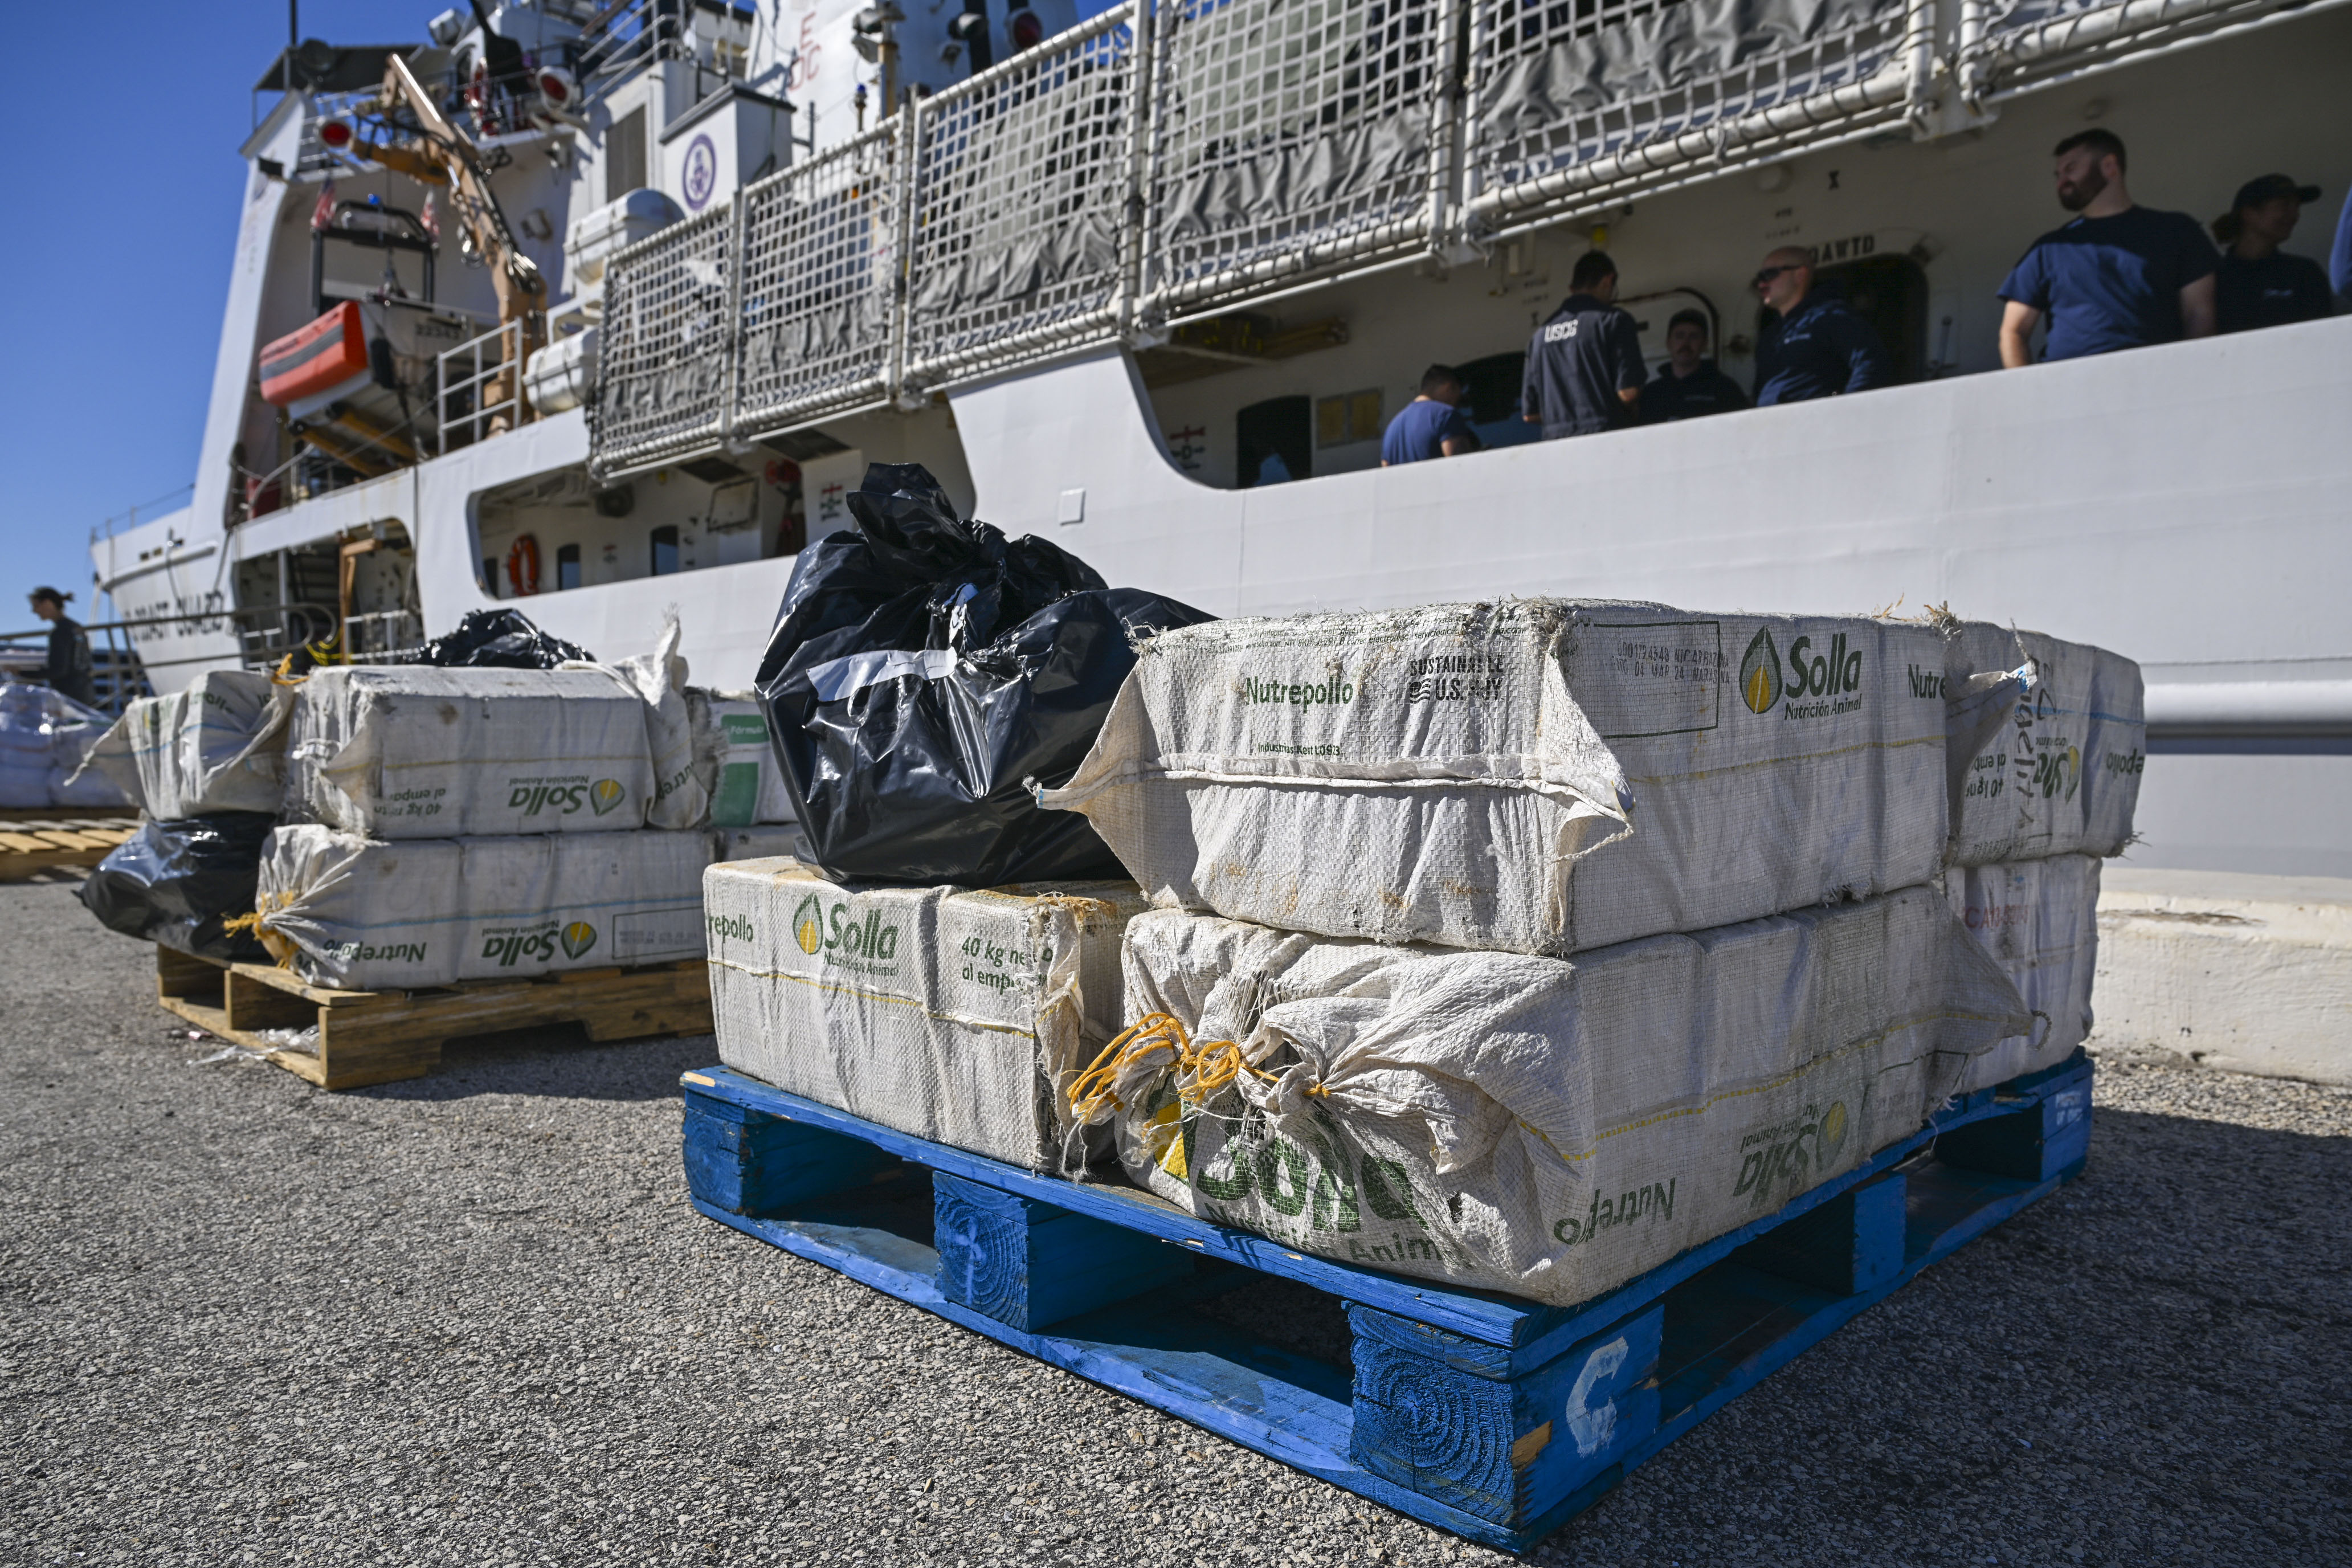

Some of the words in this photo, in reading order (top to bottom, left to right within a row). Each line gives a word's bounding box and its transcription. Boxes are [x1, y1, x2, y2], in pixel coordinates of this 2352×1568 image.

[1545, 319, 1578, 342] USCG
[1635, 661, 1644, 677] 04
[1652, 663, 1669, 678] MAR
[1785, 632, 1863, 699] Solla
[1246, 676, 1353, 713] Nutrepollo
[1435, 677, 1464, 701] U.S.
[1785, 700, 1830, 720] Nutrición
[1831, 693, 1862, 716] Animal
[1257, 741, 1294, 754] Industrias
[1297, 744, 1313, 756] Kent
[406, 802, 423, 817] kg
[423, 802, 442, 815] 40
[508, 785, 588, 816] Solla
[824, 902, 899, 959] Solla
[481, 931, 560, 966] Solla
[961, 937, 981, 957] 40
[984, 940, 1005, 967] kg
[962, 963, 974, 981] al
